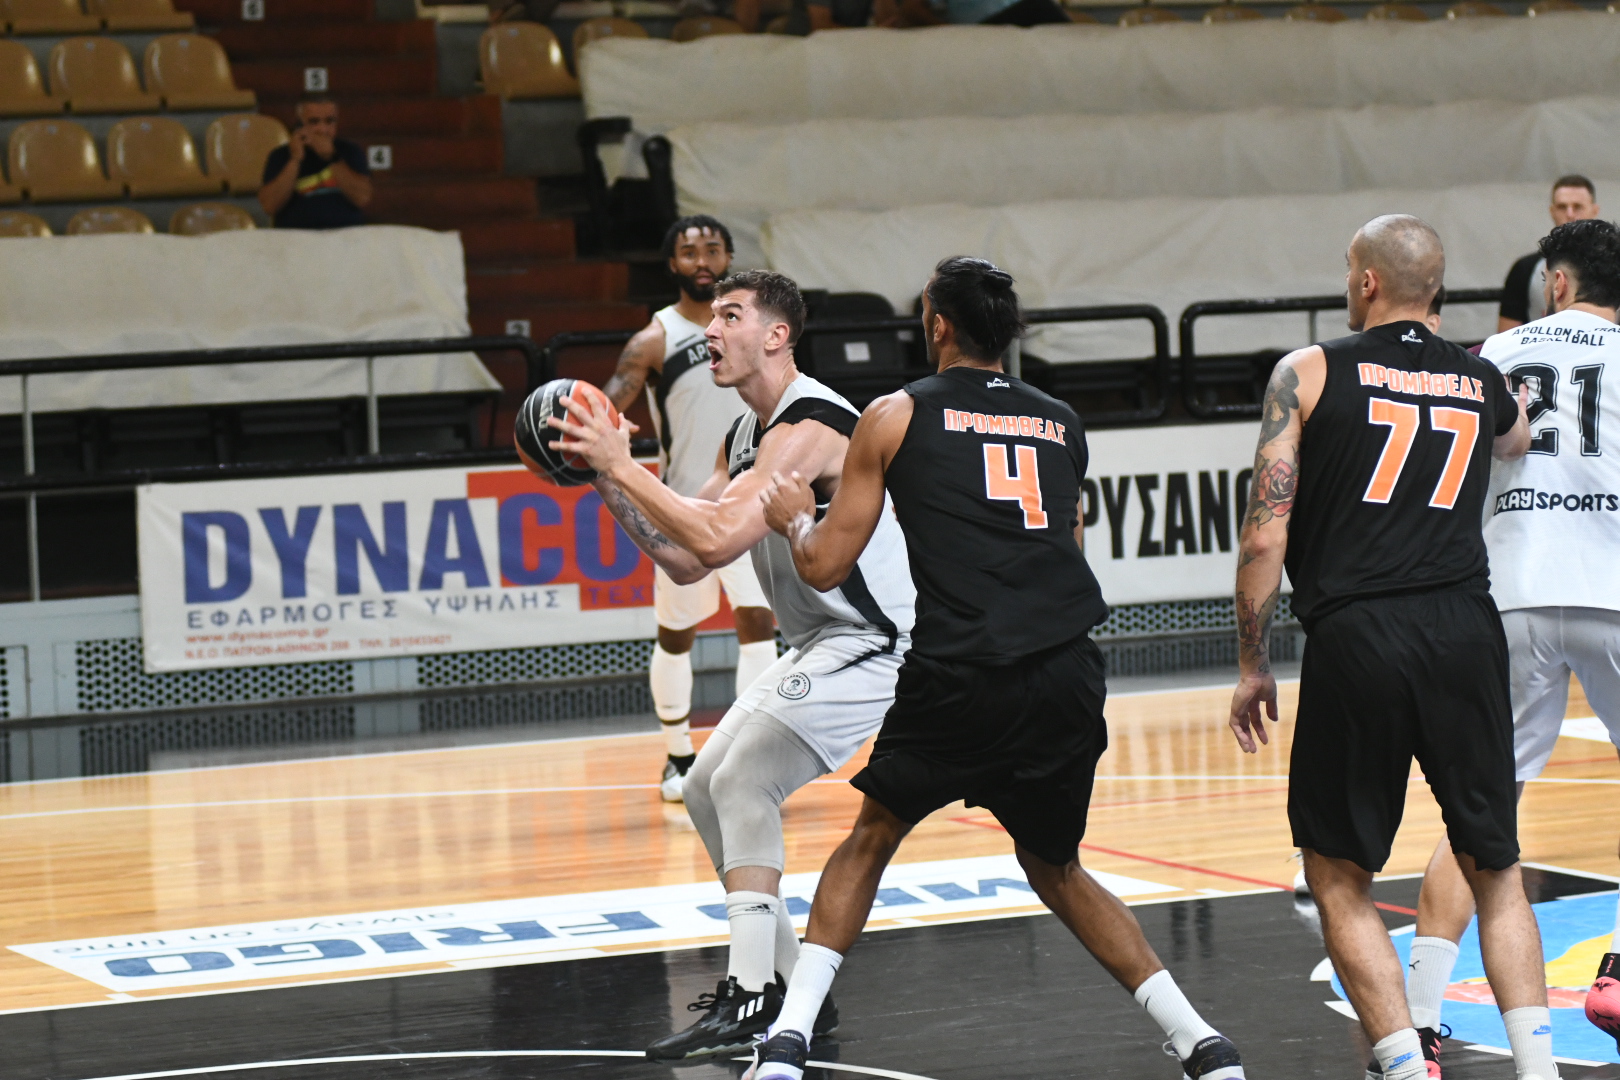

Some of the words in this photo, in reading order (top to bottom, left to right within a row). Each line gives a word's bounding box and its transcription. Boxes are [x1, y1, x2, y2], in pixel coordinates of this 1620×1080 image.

[1512, 326, 1572, 336] APOLLON
[1358, 363, 1484, 403] ΠΡΟΜΗΘΕΑΣ
[944, 408, 1066, 446] ΠΡΟΜΗΘΕΑΣ
[1507, 363, 1605, 457] 21
[1362, 397, 1480, 510] 77
[983, 443, 1048, 529] 4
[186, 600, 398, 629] ΕΦΑΡΜΟΓΕΣ
[425, 588, 560, 616] ΥΨΗΛΗΣ
[189, 930, 253, 942] on
[274, 912, 454, 931] always
[52, 938, 167, 955] time
[103, 911, 664, 978] FRIGO
